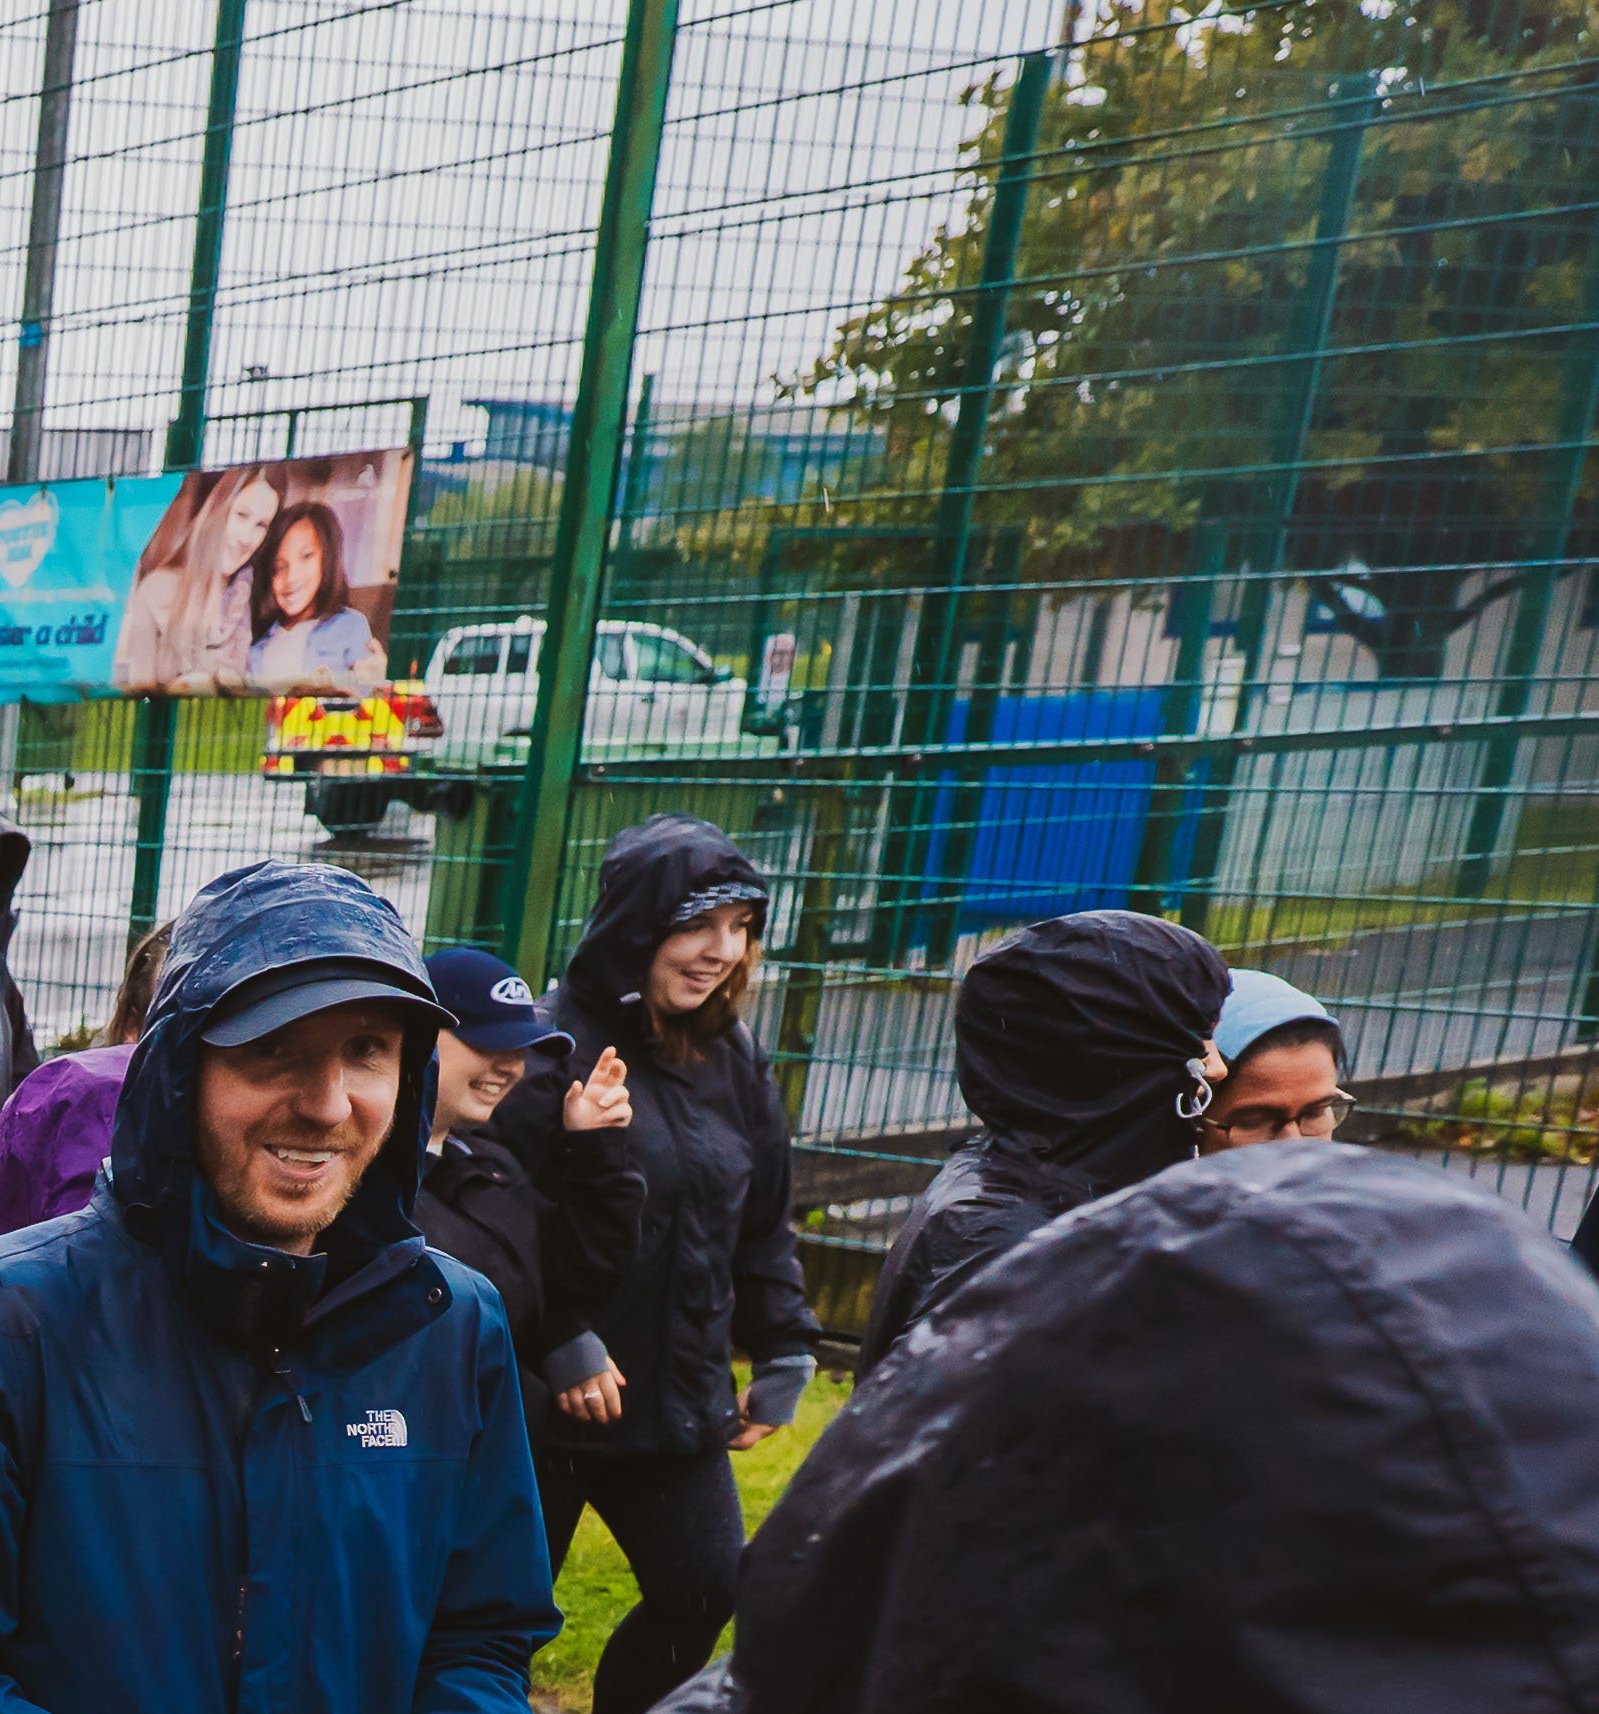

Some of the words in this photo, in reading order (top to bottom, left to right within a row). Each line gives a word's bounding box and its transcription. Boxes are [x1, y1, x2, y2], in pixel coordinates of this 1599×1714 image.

[36, 624, 51, 645] a
[55, 612, 109, 645] child
[366, 1410, 392, 1422] THE
[346, 1422, 392, 1436] NORTH
[361, 1435, 394, 1447] FACE
